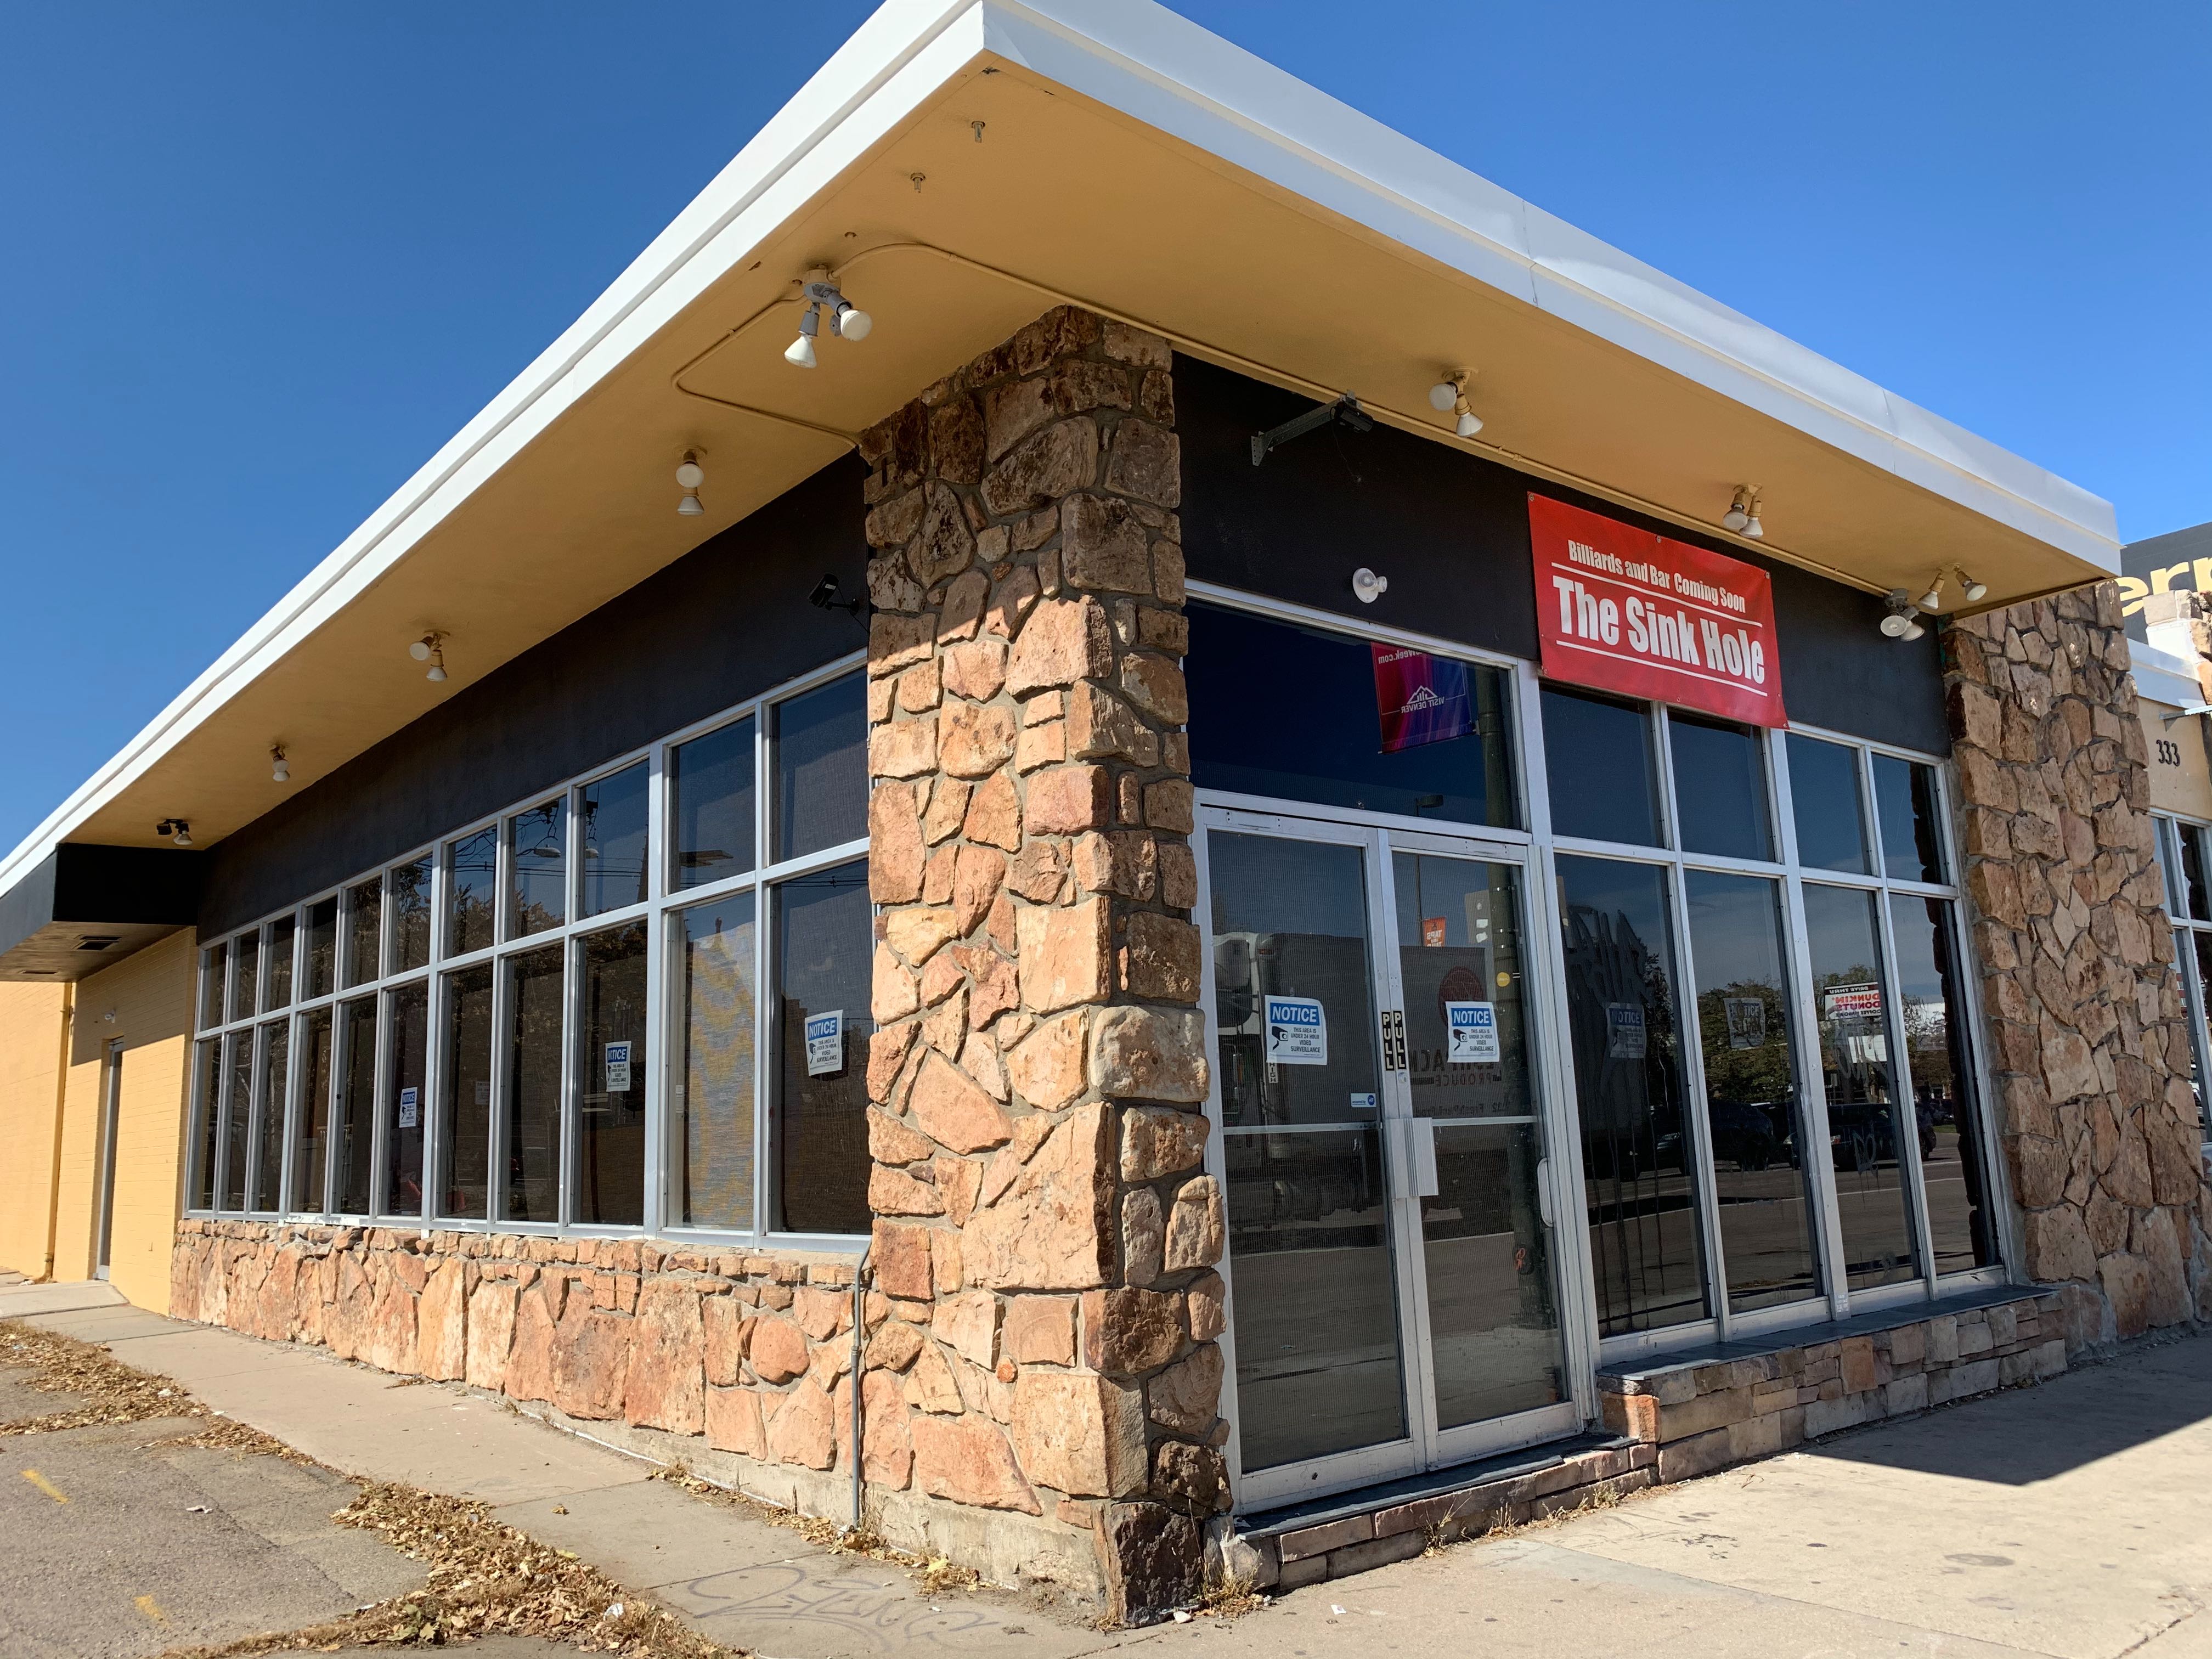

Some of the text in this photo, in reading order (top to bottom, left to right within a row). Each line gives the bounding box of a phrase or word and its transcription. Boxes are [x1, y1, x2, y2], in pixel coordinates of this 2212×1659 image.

[1567, 539, 1746, 613] Billiards and Bar Coming Soon
[1553, 575, 1765, 685] The Sink Hole
[2155, 740, 2181, 767] 333
[809, 1019, 836, 1038] NOTICE
[1272, 1006, 1317, 1023] NOTICE
[1453, 1011, 1489, 1024] NOTICE
[1383, 1013, 1393, 1069] PULL
[1394, 1012, 1405, 1068] PULL
